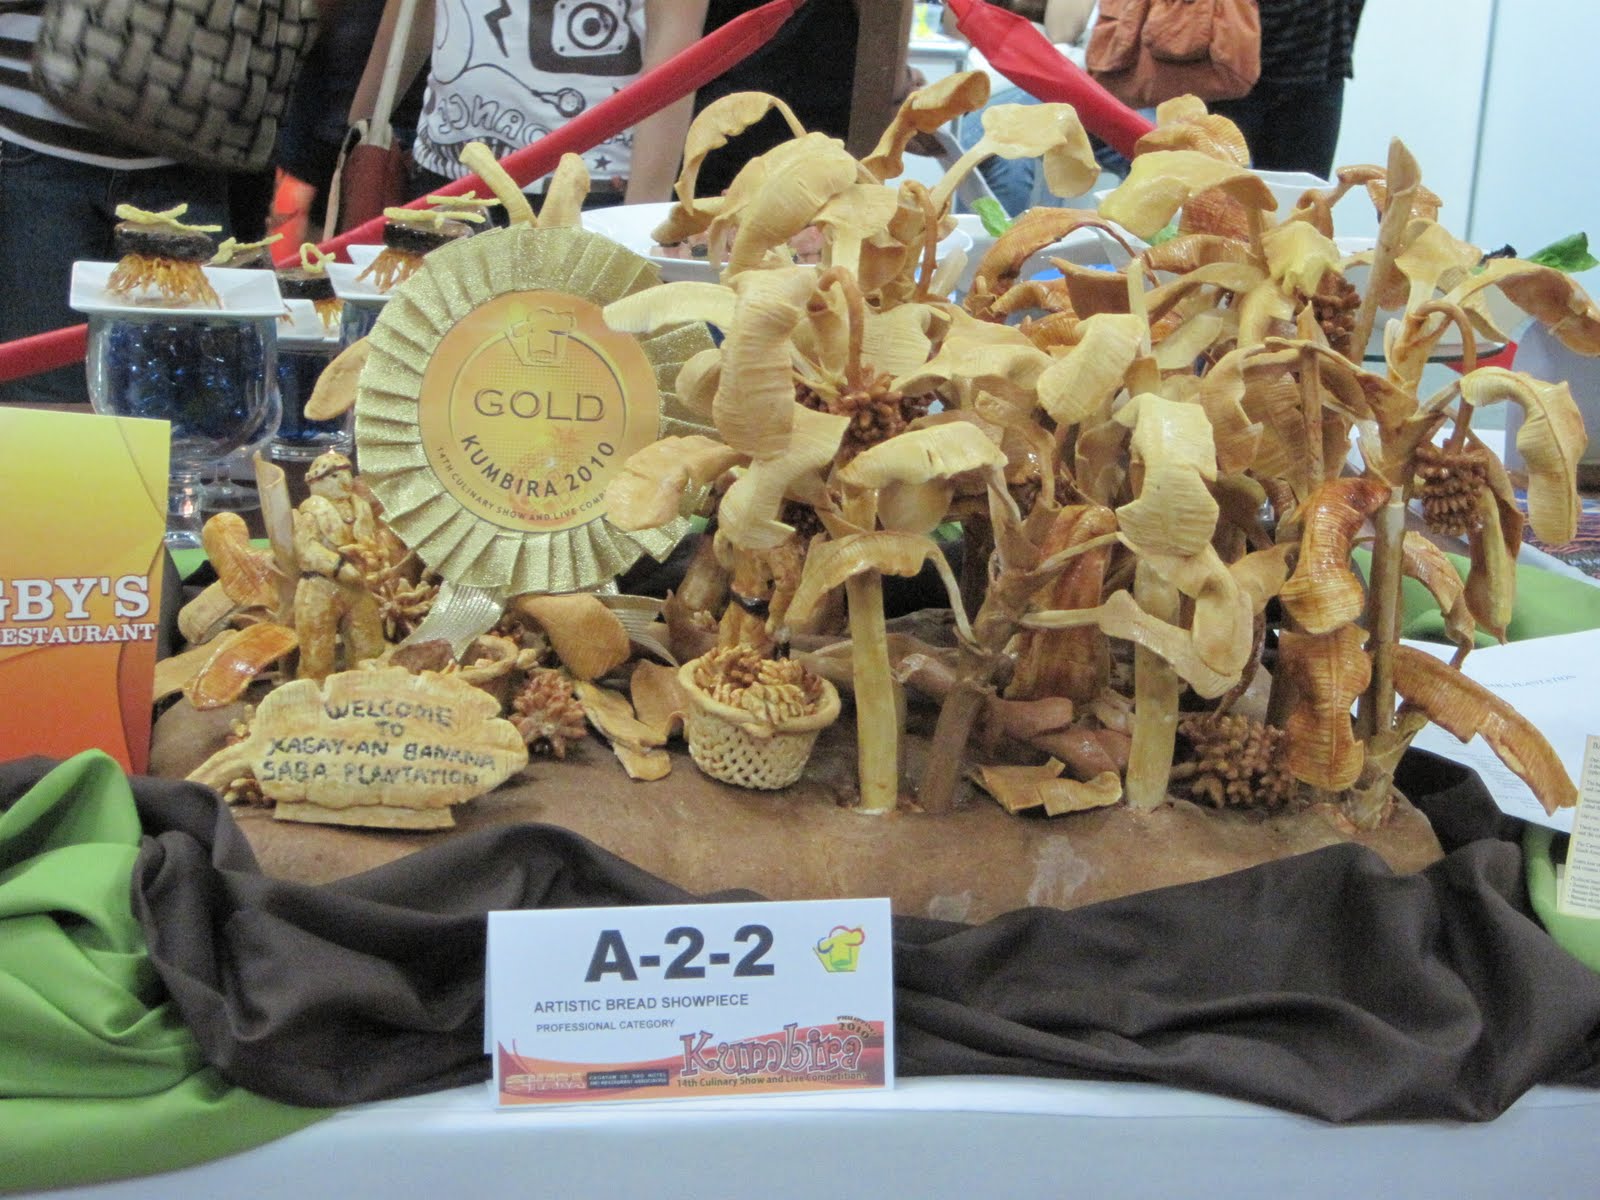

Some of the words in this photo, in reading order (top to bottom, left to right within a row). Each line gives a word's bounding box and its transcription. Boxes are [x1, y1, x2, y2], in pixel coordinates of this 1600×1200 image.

[474, 388, 606, 422] GOLD
[461, 434, 558, 498] KUMBIRA
[564, 442, 615, 491] 2010
[451, 472, 494, 510] CULINARY
[495, 506, 526, 520] SHOW
[528, 513, 551, 521] AND
[553, 507, 577, 520] LIVE
[579, 489, 606, 512] COMP
[0, 575, 150, 621] BY'S
[0, 623, 155, 646] ESTAURANT
[323, 700, 452, 727] WELCOME
[375, 720, 404, 737] TO
[262, 760, 328, 782] SABA
[344, 762, 478, 785] PLANTATION
[584, 924, 775, 982] A-2-2
[534, 1000, 601, 1013] ARTISTIC
[606, 998, 657, 1010] BREAD
[661, 994, 749, 1008] SHOWPIECE
[536, 1022, 616, 1033] PROFESSIONAL
[619, 1019, 675, 1029] CATEGORY
[839, 1022, 870, 1039] 2010
[679, 1022, 863, 1077] Kumbira
[677, 1079, 698, 1088] 14th
[700, 1077, 738, 1087] Culinary
[739, 1076, 765, 1085] Show
[766, 1075, 784, 1084] and
[786, 1074, 804, 1083] Live
